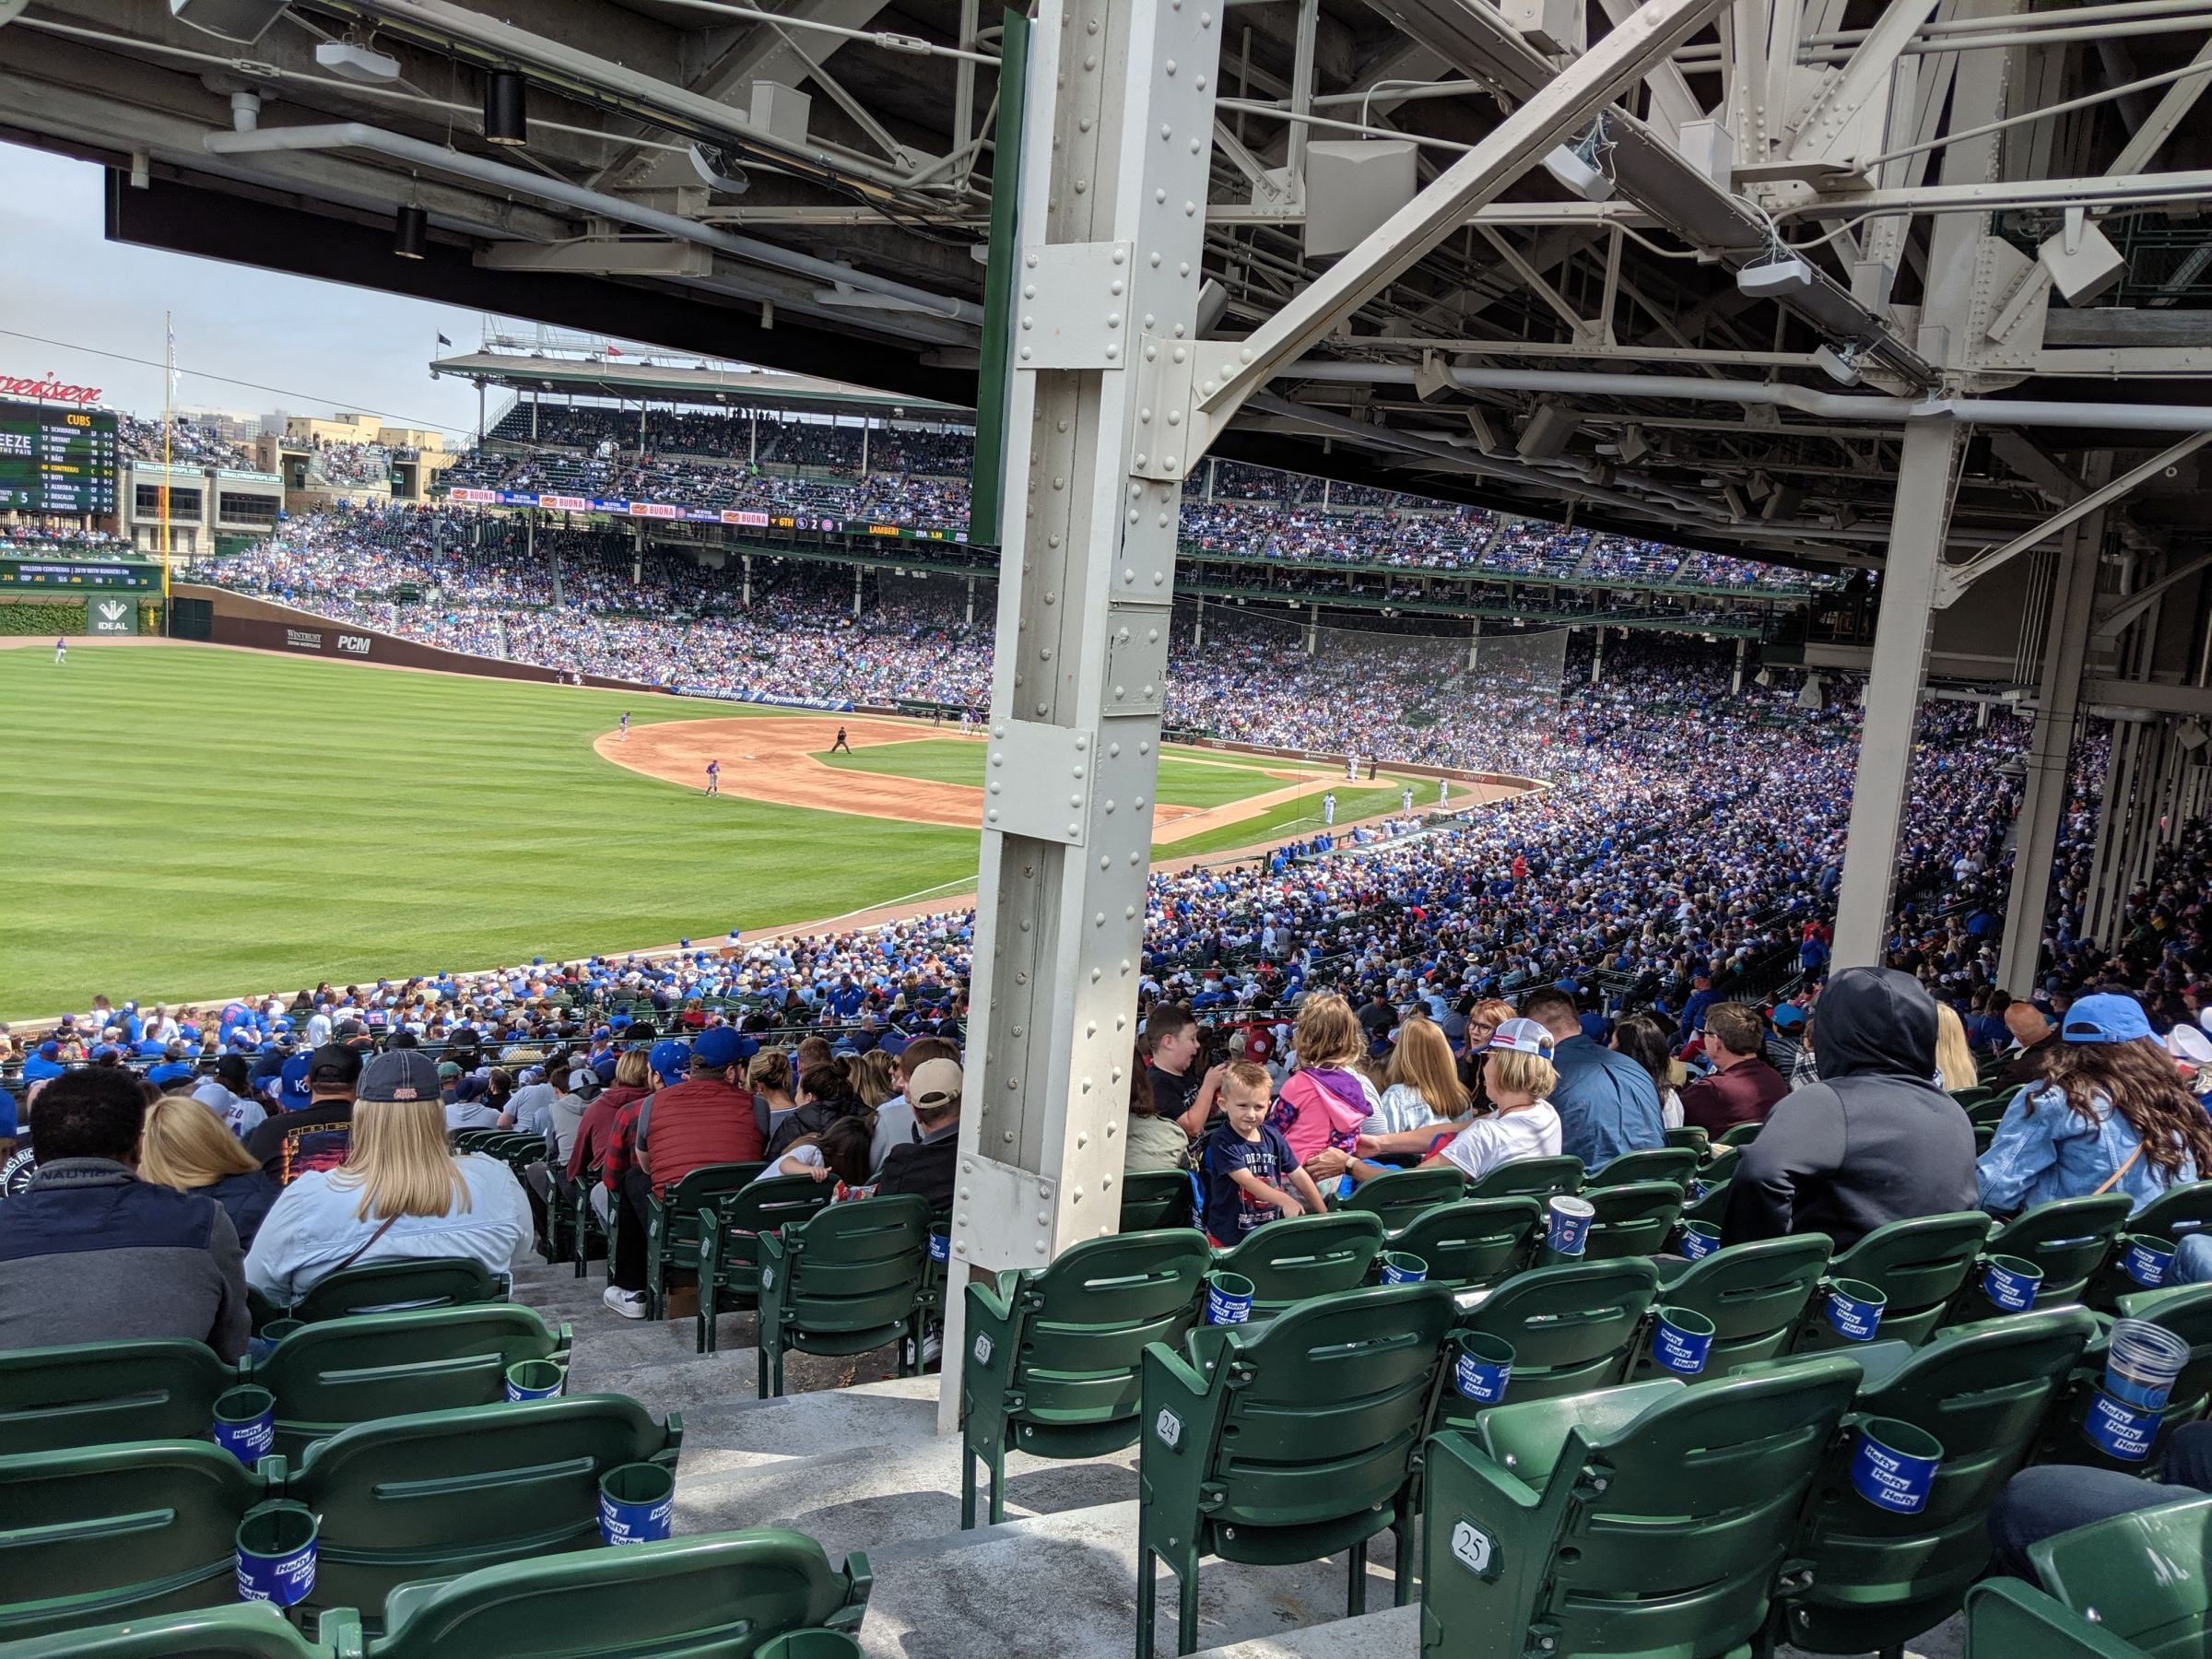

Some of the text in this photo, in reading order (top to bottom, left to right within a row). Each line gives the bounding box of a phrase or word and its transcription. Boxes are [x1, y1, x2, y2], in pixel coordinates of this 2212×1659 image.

[67, 414, 91, 427] CUBS
[51, 426, 80, 435] SCHWARBER
[51, 465, 79, 474] CONTRERAS
[220, 471, 280, 482] WRIGLEYROOFTOPS.COM
[21, 492, 28, 503] 5
[470, 489, 493, 500] BUONA
[559, 498, 583, 509] BUONA
[649, 506, 674, 516] BUONA
[741, 513, 767, 525] BUONA
[780, 518, 842, 531] 6TH 2 1
[869, 525, 900, 536] LAMBERT
[915, 530, 927, 538] ERA
[98, 622, 129, 630] IDEAL
[337, 635, 371, 652] PCM
[677, 686, 743, 700] Reynolds Wrap
[763, 693, 830, 708] Reynolds Wrap
[1838, 1309, 1858, 1323] Hefty
[1844, 1324, 1865, 1334] Hefty
[1662, 1330, 1681, 1344] Hefty
[977, 1339, 988, 1358] 23
[1667, 1345, 1689, 1358] Hefty
[1675, 1359, 1698, 1368] Hefty
[1460, 1367, 1481, 1383] Hefty
[1465, 1383, 1489, 1396] Hefty
[2100, 1401, 2131, 1422] Hefty
[235, 1425, 261, 1438] Hefty
[1160, 1415, 1175, 1440] 24
[2108, 1421, 2140, 1440] Hefty
[2117, 1440, 2147, 1453] Hefty
[1866, 1447, 1896, 1470] Hefty
[1874, 1469, 1908, 1489] Hefty
[1884, 1490, 1917, 1505] Hefty
[605, 1516, 628, 1534] Hefty
[1458, 1529, 1483, 1561] 25
[278, 1554, 310, 1572] Hefty
